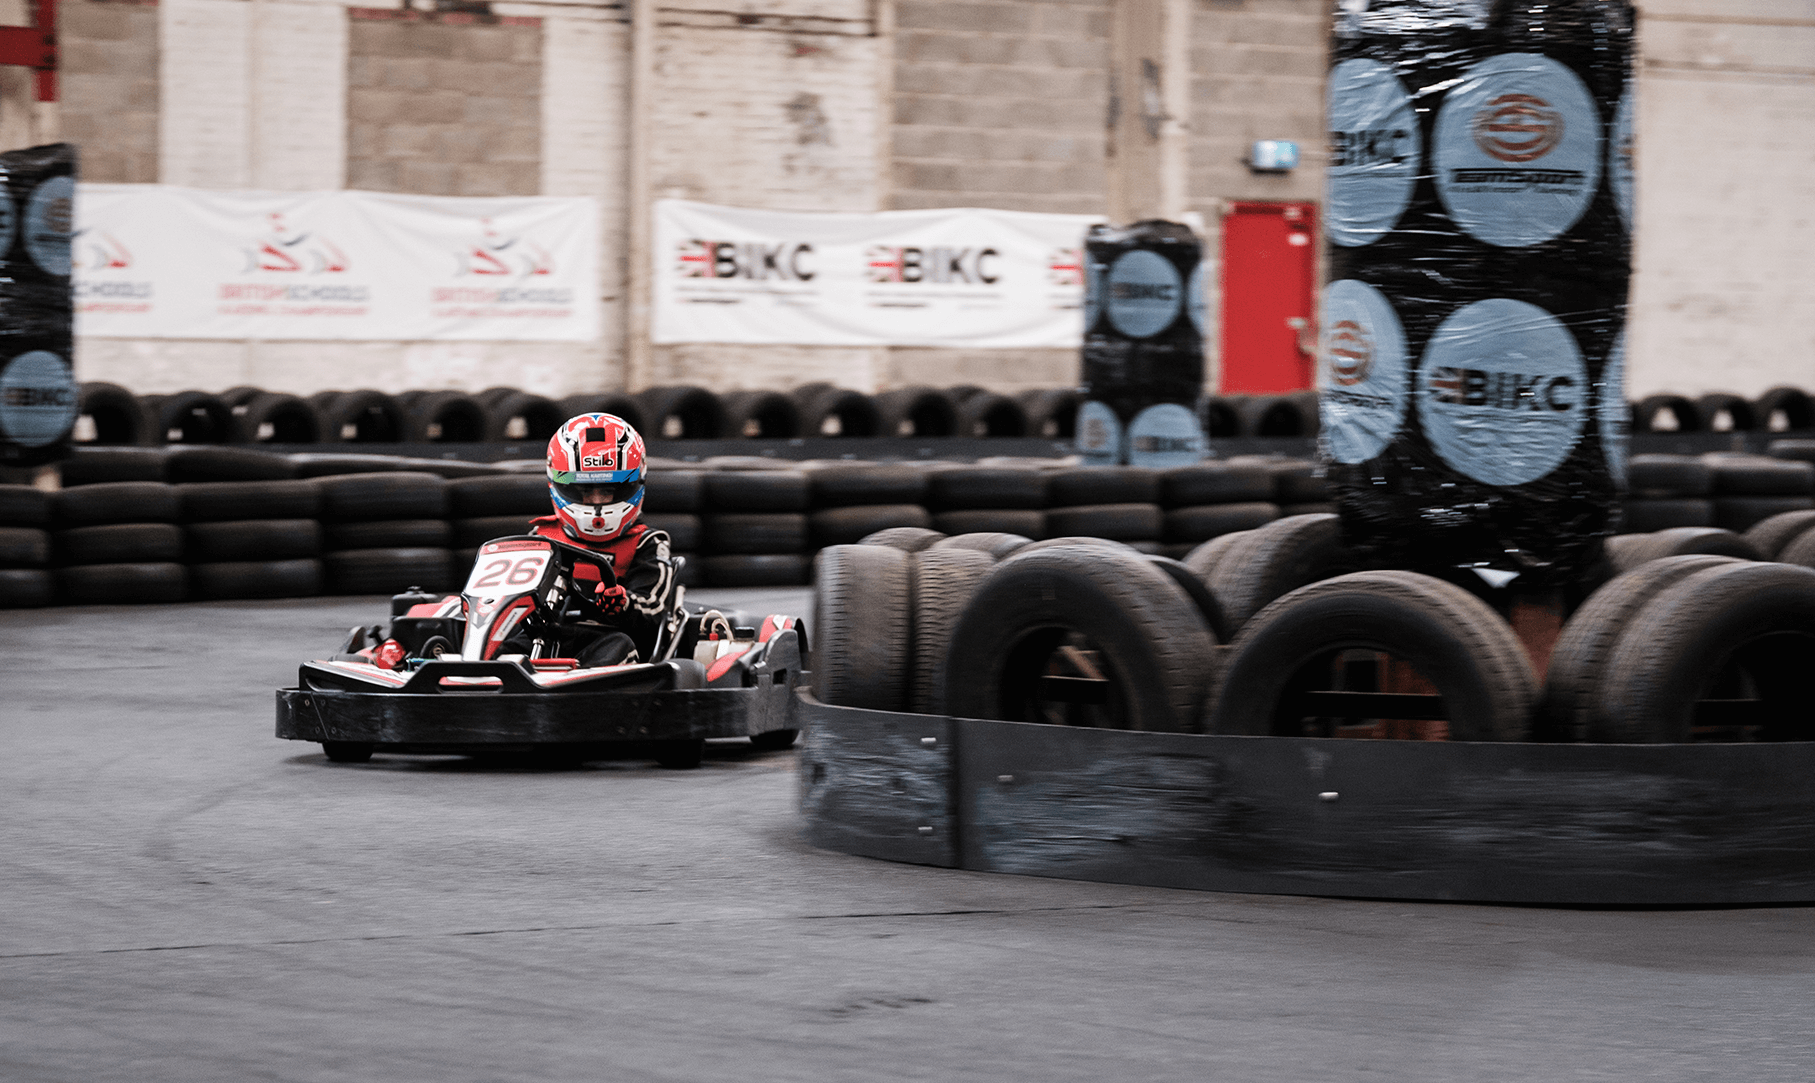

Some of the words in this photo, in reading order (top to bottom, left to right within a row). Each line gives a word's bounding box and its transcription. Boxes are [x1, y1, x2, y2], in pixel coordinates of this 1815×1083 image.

[713, 242, 817, 281] BIKC
[901, 247, 1002, 284] BIKC
[1464, 369, 1573, 411] BIKC
[583, 453, 614, 466] Stilo
[473, 556, 545, 589] 26
